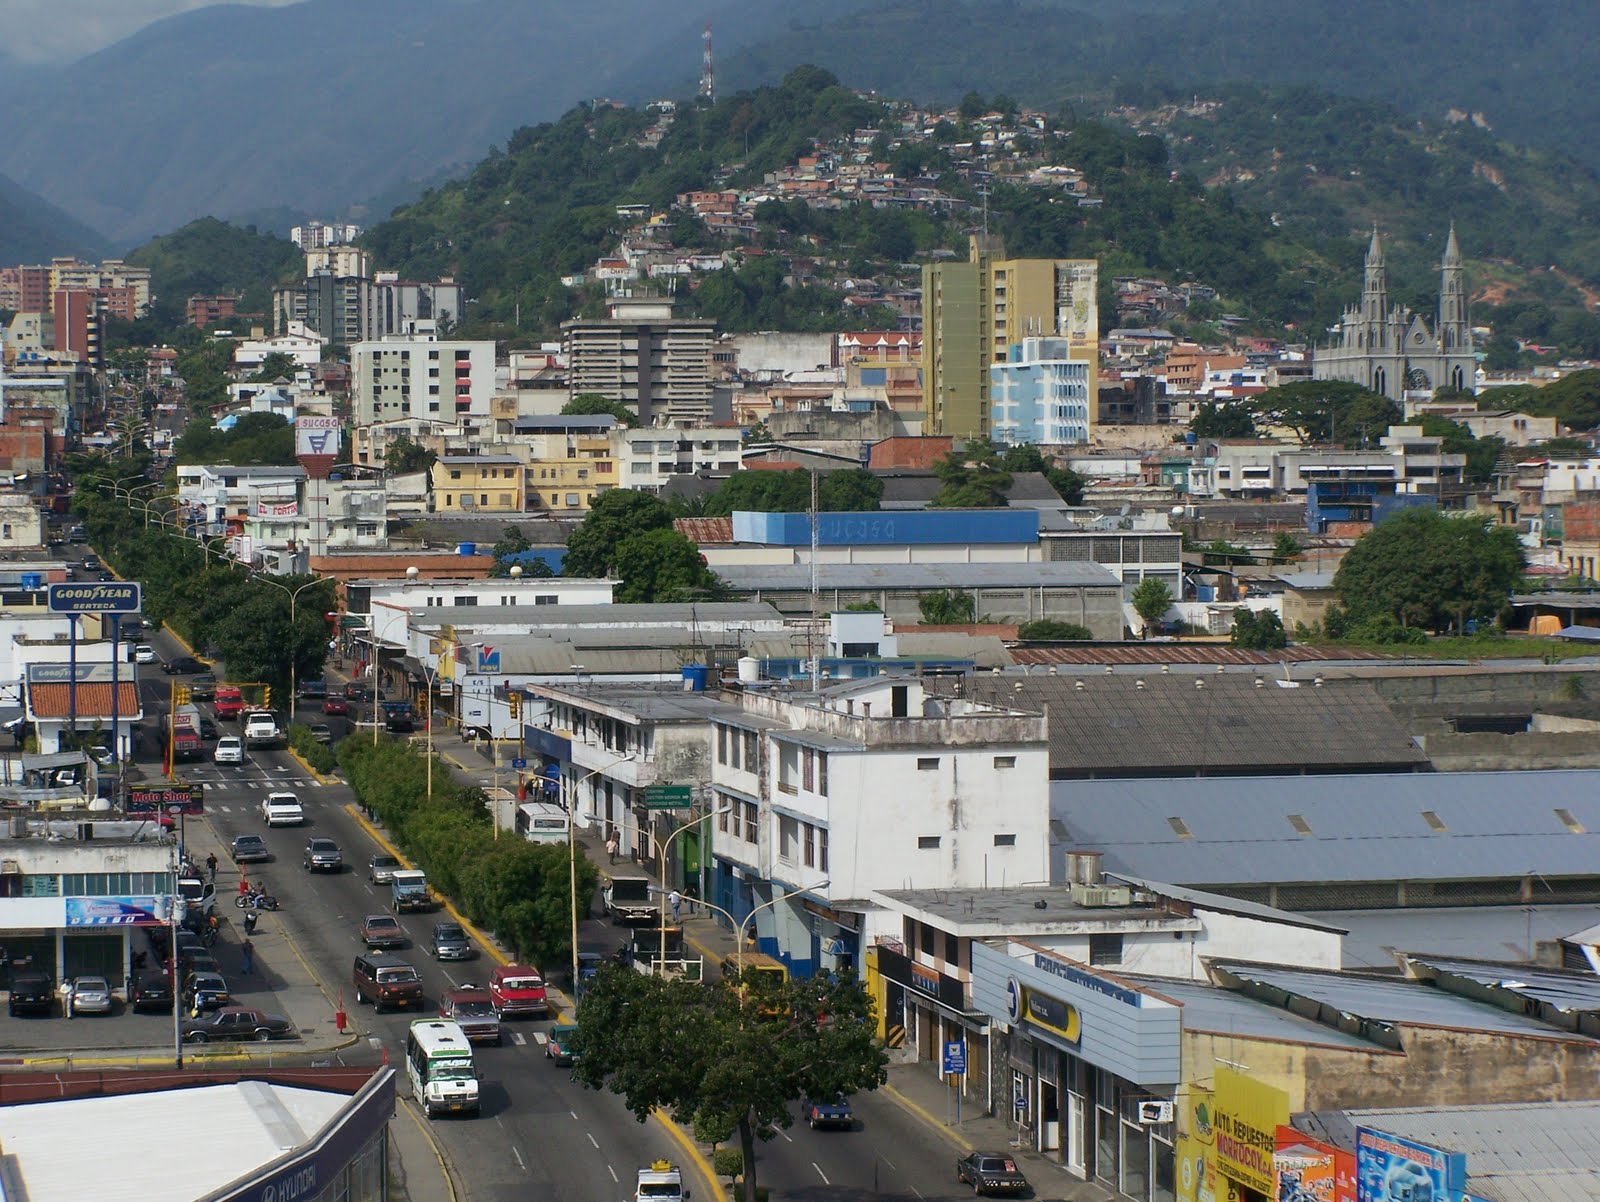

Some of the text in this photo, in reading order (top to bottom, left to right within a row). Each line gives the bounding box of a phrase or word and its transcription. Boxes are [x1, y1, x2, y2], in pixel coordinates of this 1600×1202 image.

[56, 587, 132, 600] GOODYEAR
[132, 791, 191, 803] Moto Shop
[1233, 1119, 1274, 1154] REPUESTOS
[279, 1161, 317, 1202] HYUNDAI
